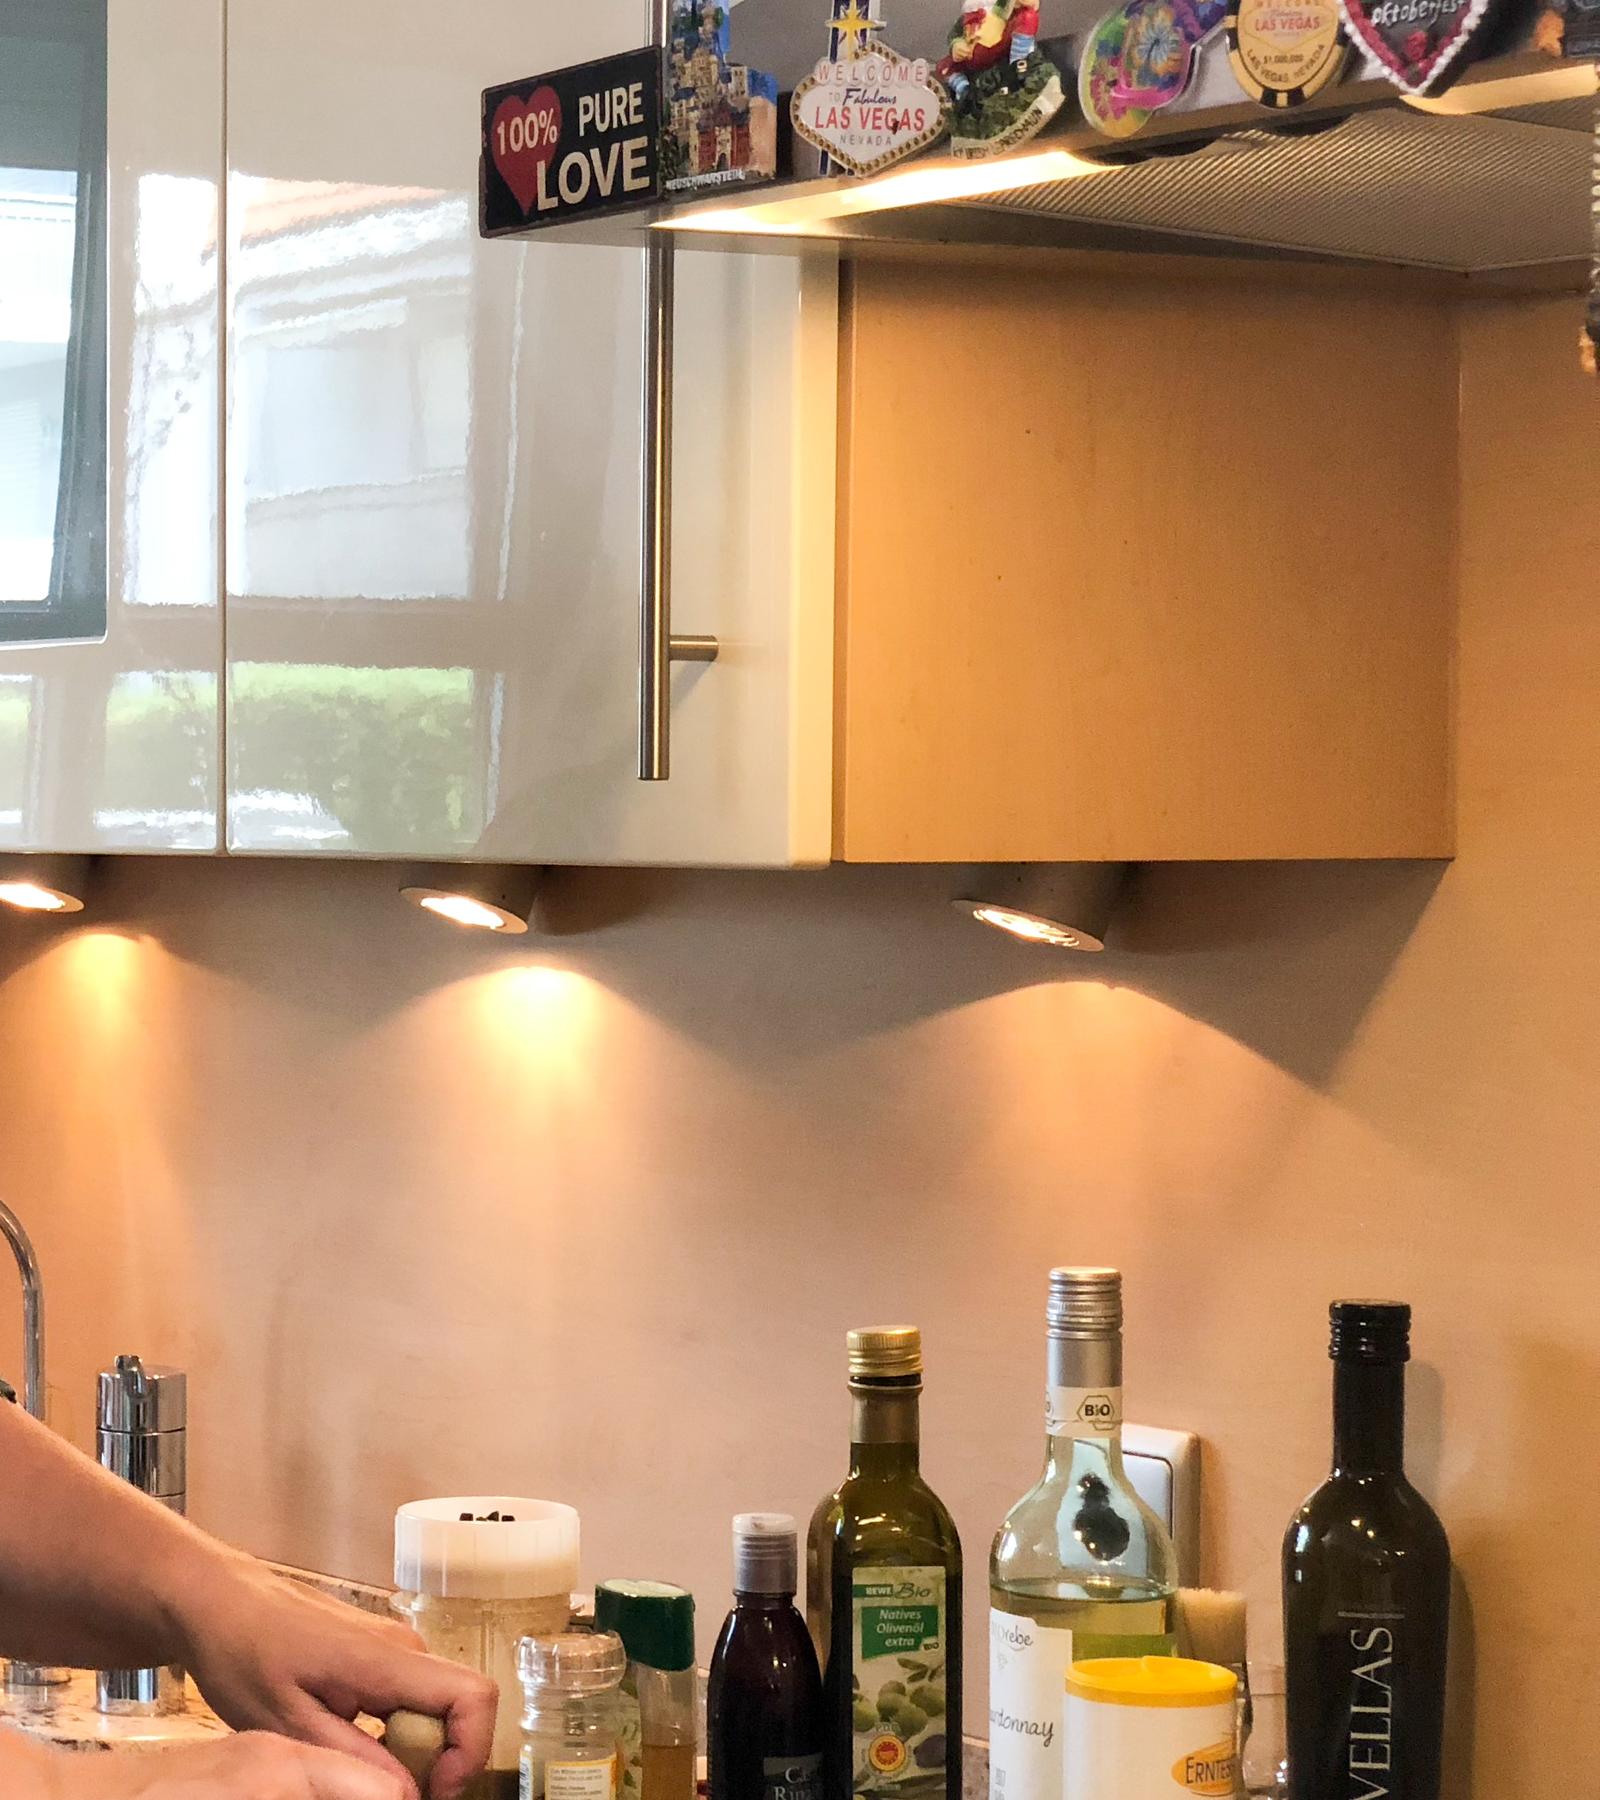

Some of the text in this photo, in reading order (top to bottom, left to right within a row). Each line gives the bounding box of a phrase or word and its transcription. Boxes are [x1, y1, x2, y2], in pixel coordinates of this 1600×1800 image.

[1255, 16, 1320, 32] LAS VEGAS
[819, 64, 924, 81] WELCOME
[842, 87, 897, 106] Fabulous
[578, 82, 644, 137] PURE
[815, 105, 926, 132] LAS VEGAS
[497, 107, 558, 156] 100%
[840, 134, 893, 146] NEVADA
[536, 136, 650, 211] LOVE
[895, 1582, 931, 1600] Bio
[879, 1609, 922, 1620] Natives
[876, 1622, 924, 1634] Olivenöl
[885, 1637, 916, 1648] extra
